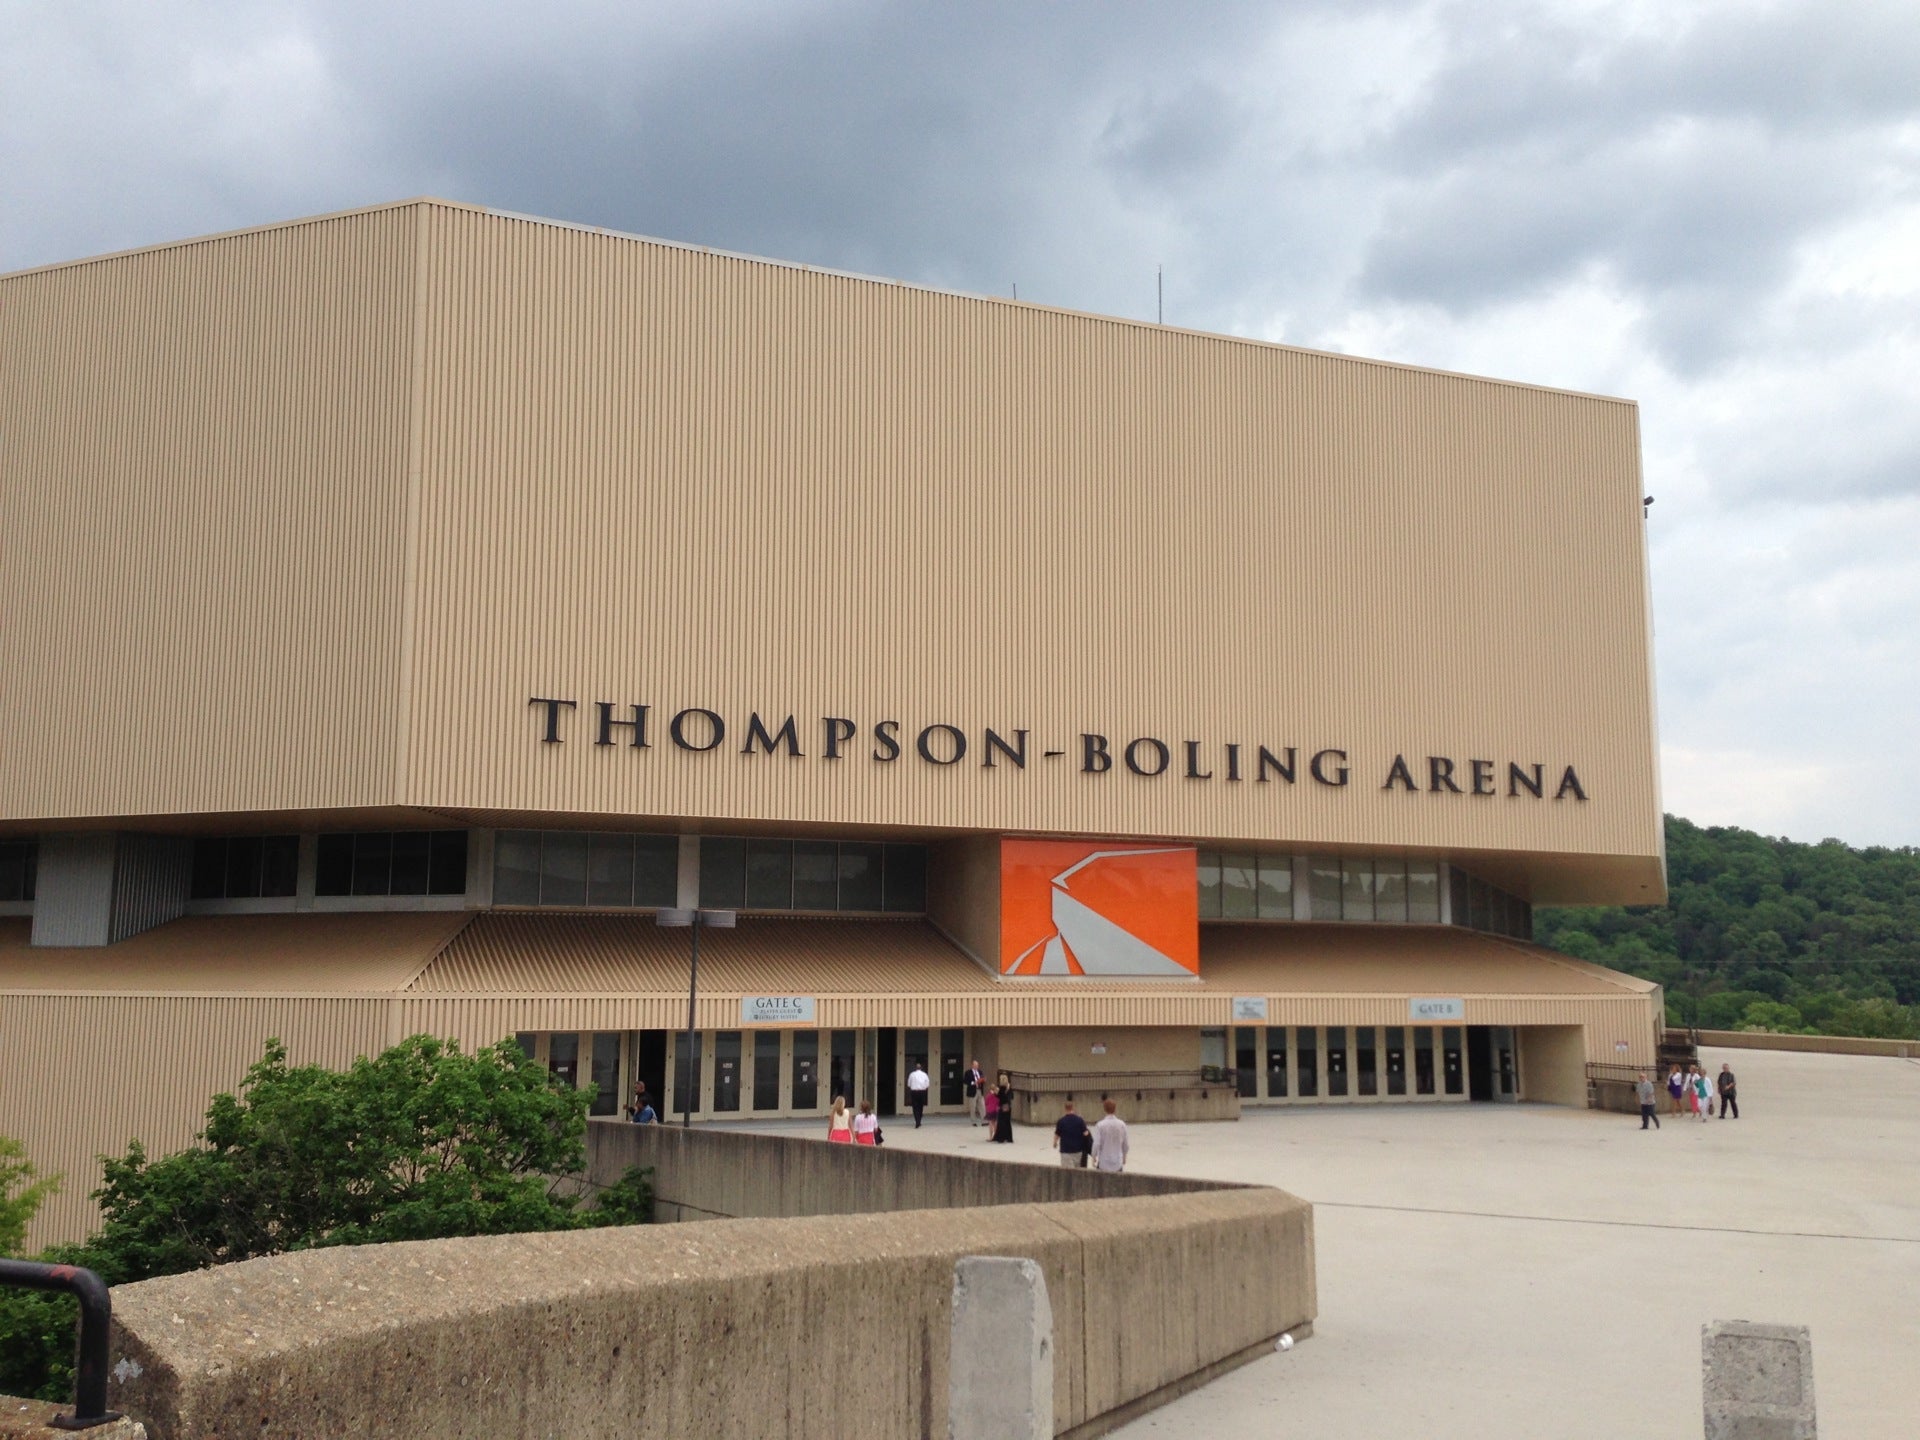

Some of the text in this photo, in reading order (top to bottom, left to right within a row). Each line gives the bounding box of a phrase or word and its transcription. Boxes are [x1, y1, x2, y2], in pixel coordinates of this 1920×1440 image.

[527, 697, 1588, 802] THOMPSON-BOLING ARENA
[756, 997, 802, 1008] GATE C
[1419, 1003, 1445, 1014] GATE
